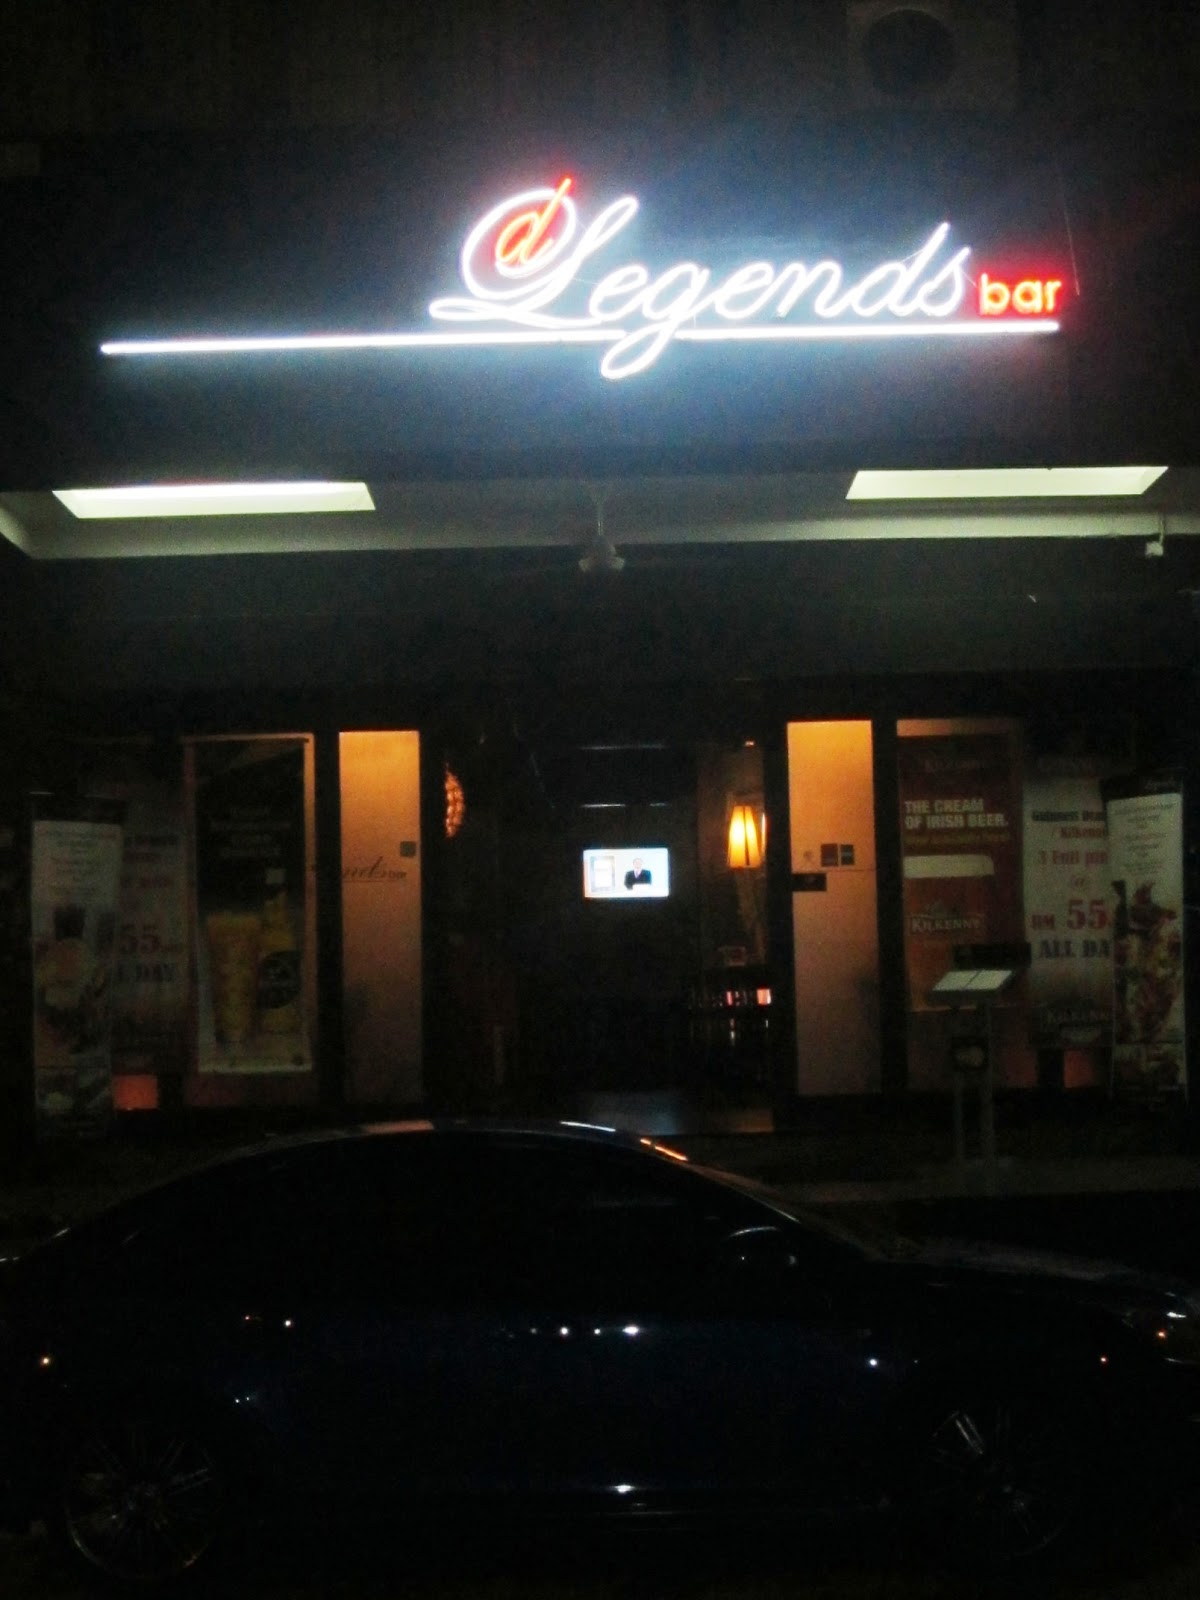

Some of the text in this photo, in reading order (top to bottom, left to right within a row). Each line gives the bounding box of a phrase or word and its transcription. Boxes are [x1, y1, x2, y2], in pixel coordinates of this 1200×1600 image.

[428, 188, 971, 380] Legends
[978, 272, 1062, 315] bar
[904, 797, 985, 814] THE CREAM
[904, 814, 924, 830] OF
[926, 813, 965, 830] IRISH
[1066, 899, 1108, 930] 55
[1082, 939, 1111, 958] DA
